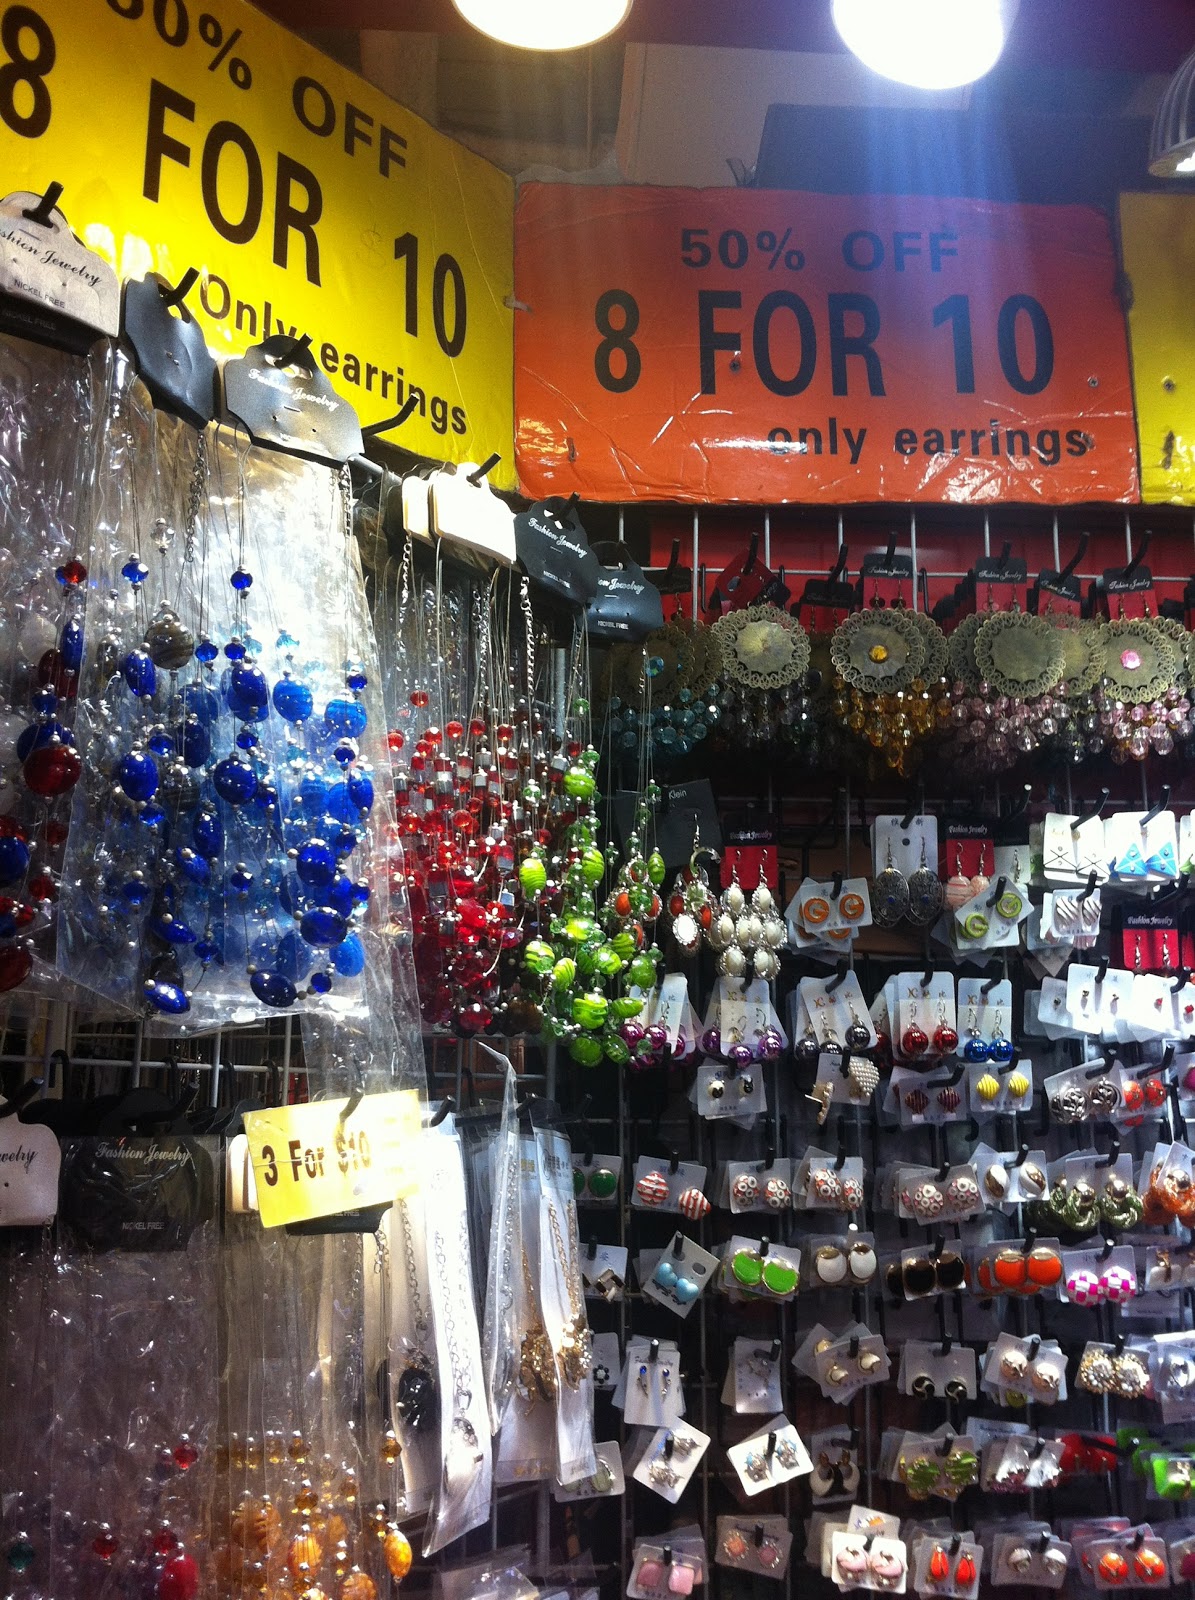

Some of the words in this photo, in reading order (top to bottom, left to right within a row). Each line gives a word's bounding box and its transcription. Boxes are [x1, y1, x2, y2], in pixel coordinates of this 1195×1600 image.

[292, 75, 408, 179] OFF
[0, 5, 56, 138] 8
[143, 78, 323, 288] FOR
[393, 231, 467, 358] 10
[0, 228, 41, 255] shion
[39, 250, 102, 287] Jewelry
[680, 228, 806, 271] 50%
[842, 228, 959, 273] OFF
[14, 278, 43, 299] NICKEL
[44, 294, 66, 309] FREE
[593, 288, 642, 394] 8
[698, 289, 886, 397] FOR
[932, 293, 1055, 396] 10
[291, 387, 340, 412] Jewelry
[320, 342, 467, 436] earrings
[768, 417, 867, 464] only
[895, 417, 1087, 465] earrings
[528, 517, 559, 542] Fashion
[555, 534, 588, 558] Jewelry
[608, 577, 645, 595] Jewelry
[95, 1141, 144, 1159] Fashion
[143, 1143, 193, 1167] Jewelry
[261, 1144, 278, 1187] 3
[288, 1139, 325, 1182] For
[147, 1221, 165, 1230] FREE
